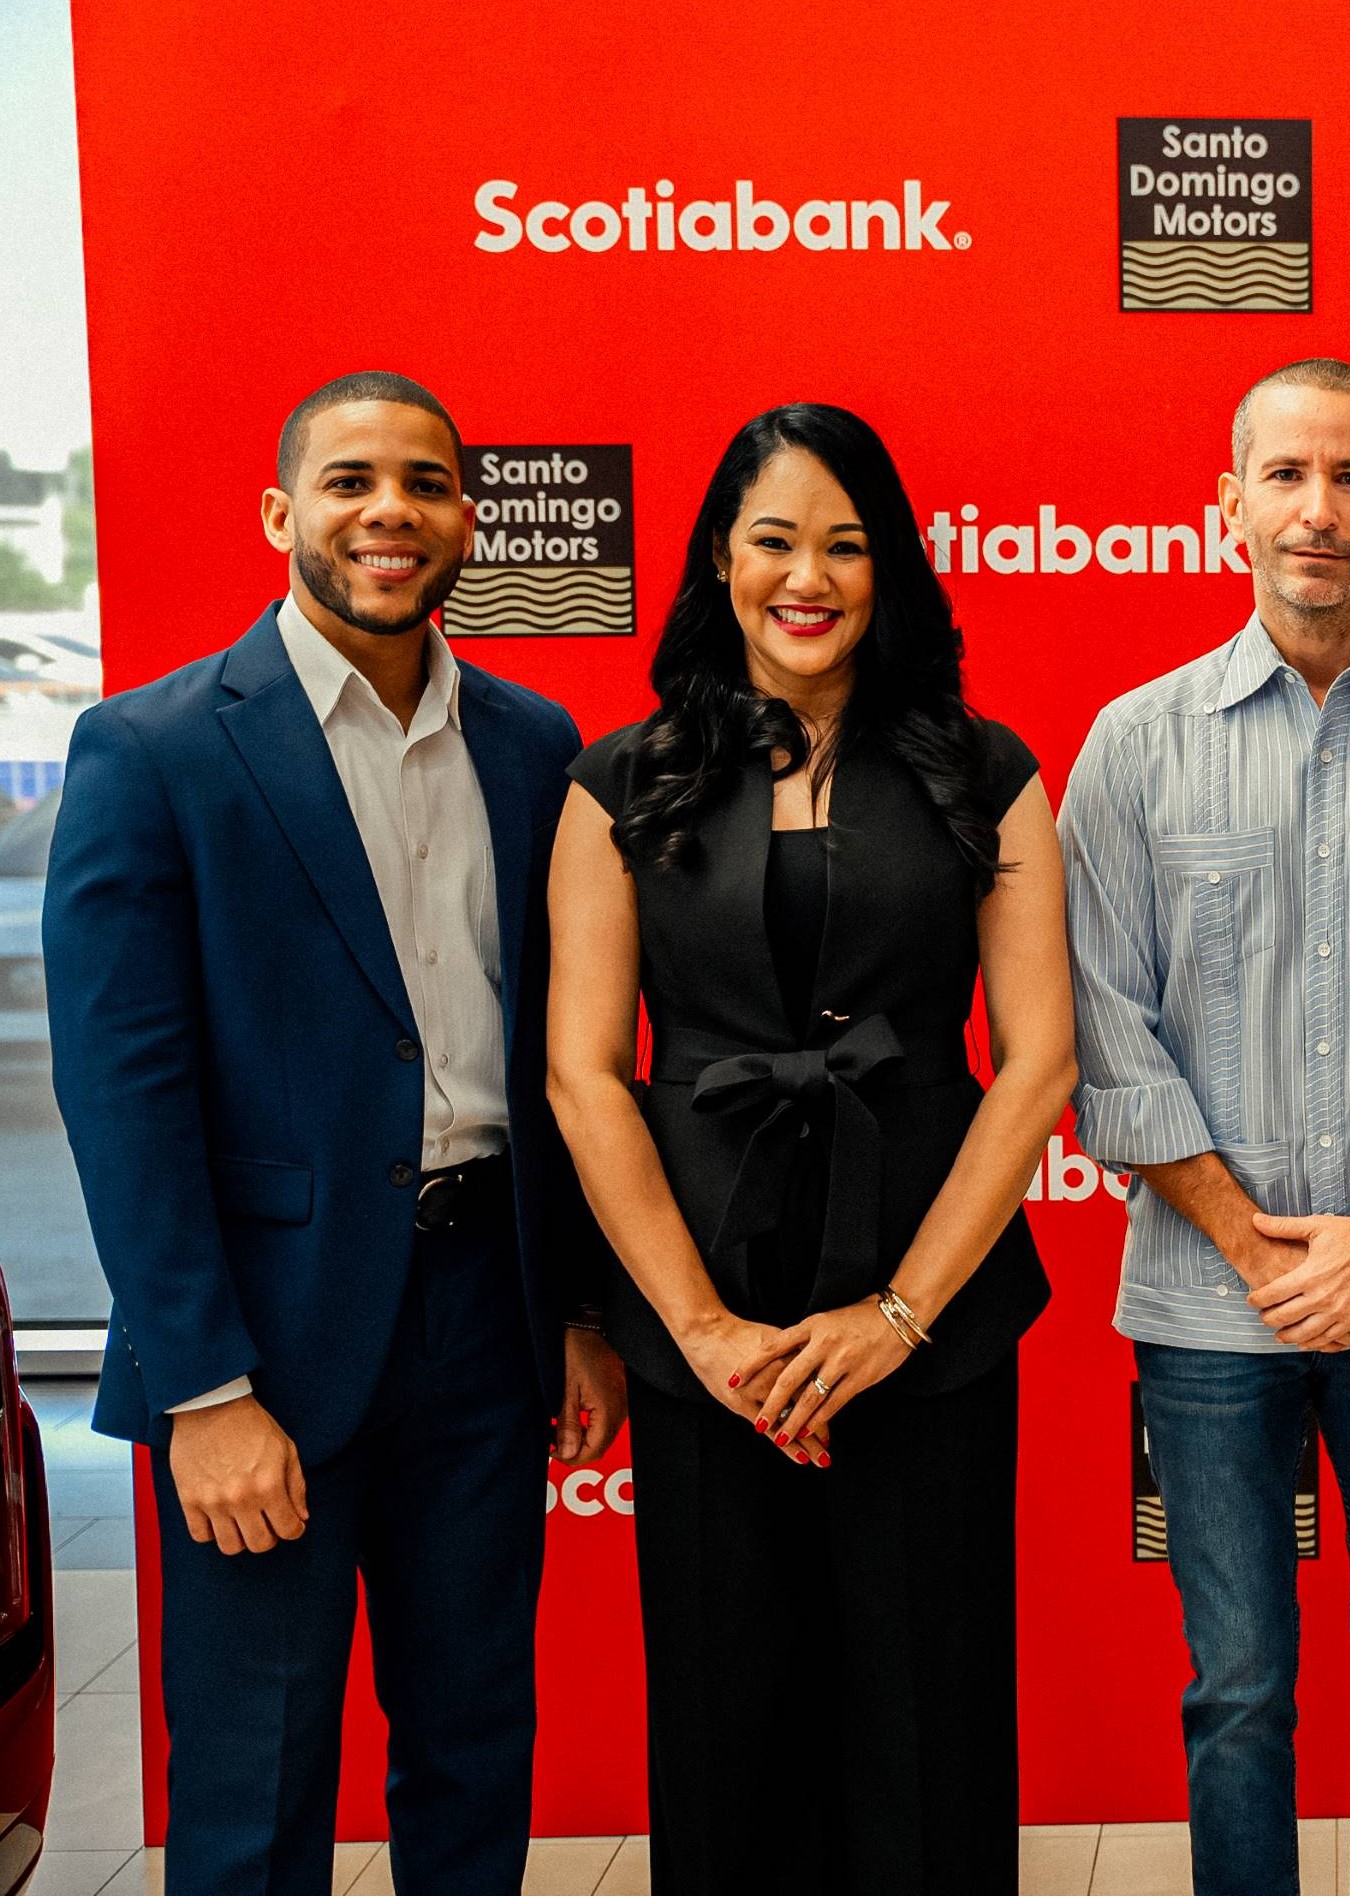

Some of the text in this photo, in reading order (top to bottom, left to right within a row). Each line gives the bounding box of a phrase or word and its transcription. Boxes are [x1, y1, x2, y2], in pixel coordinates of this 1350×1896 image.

[1162, 125, 1268, 159] Santo
[1130, 164, 1301, 206] Domingo
[1153, 203, 1278, 237] Motors
[481, 452, 588, 486] Santo
[462, 490, 622, 530] omingo
[473, 529, 599, 562] Motors
